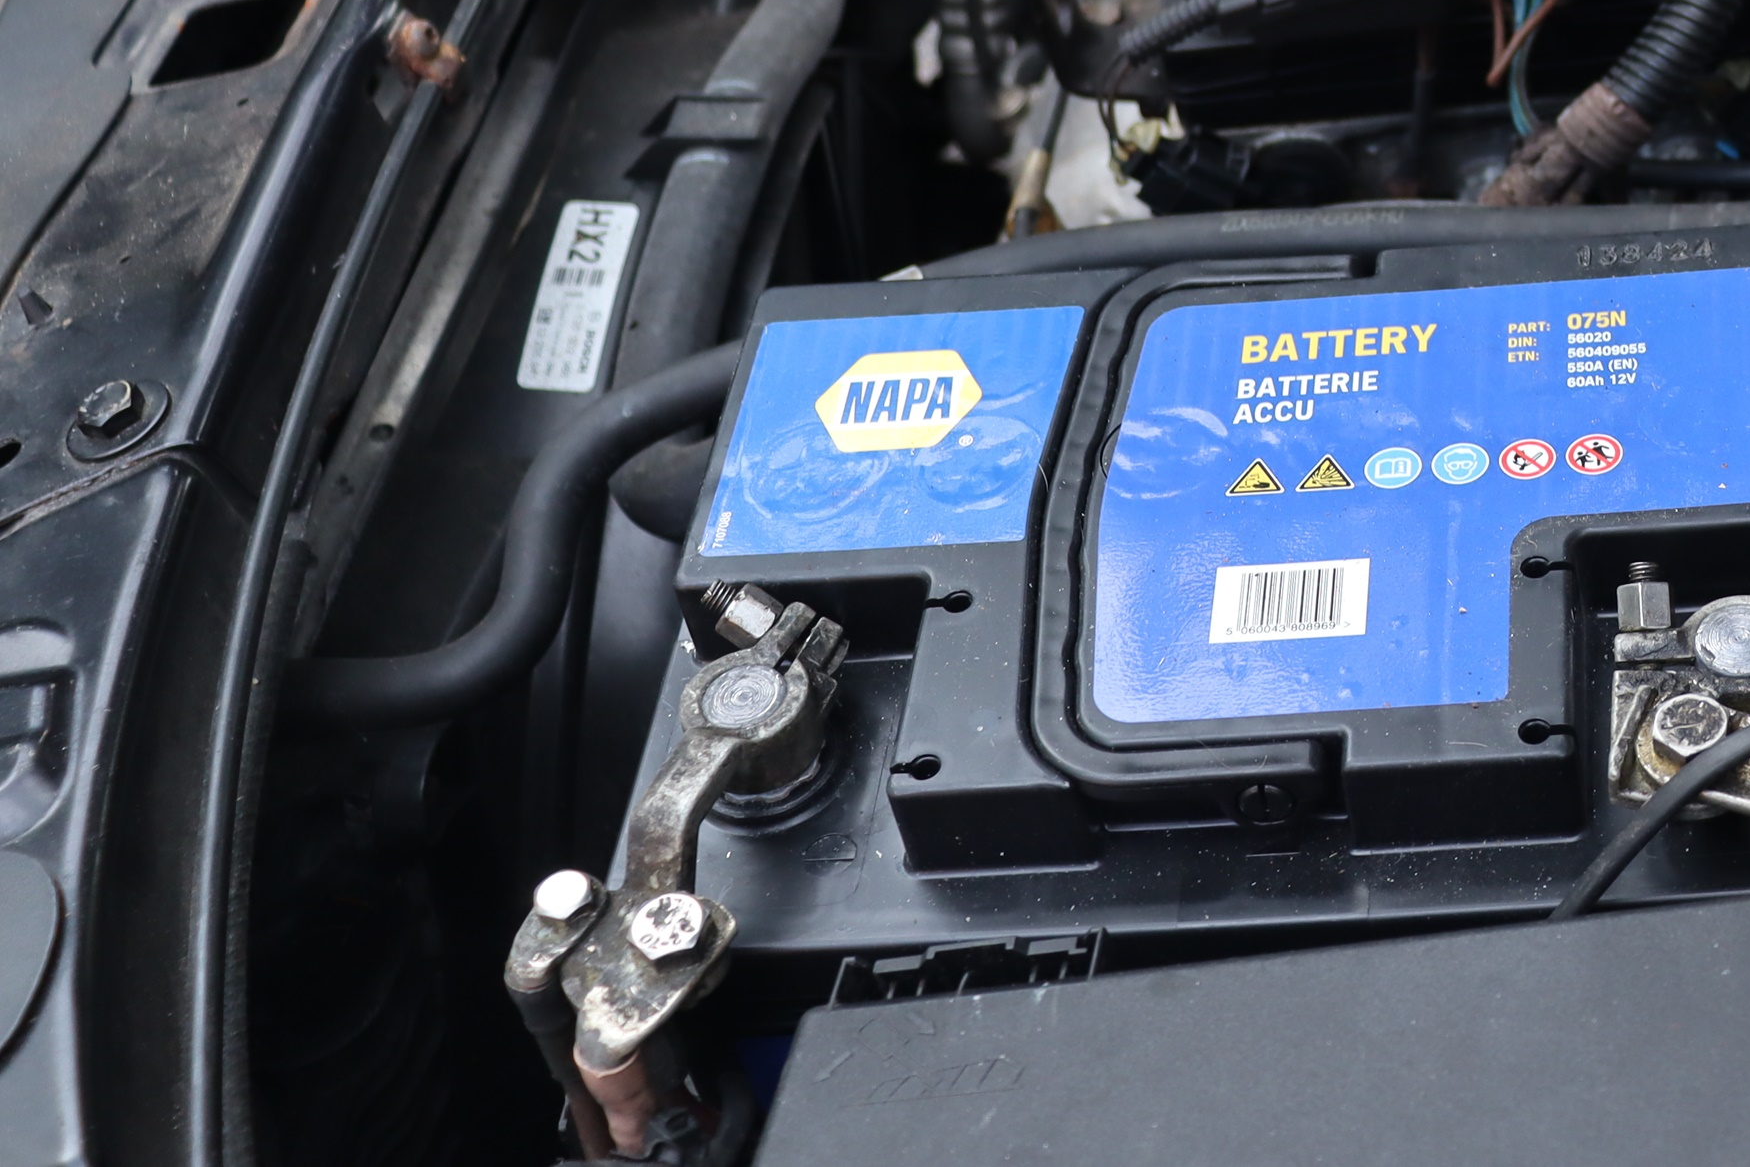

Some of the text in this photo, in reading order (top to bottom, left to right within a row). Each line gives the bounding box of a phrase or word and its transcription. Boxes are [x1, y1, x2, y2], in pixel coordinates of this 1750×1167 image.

[567, 207, 614, 264] HX2
[1577, 237, 1713, 267] 138424
[1508, 321, 1551, 334] PART:
[1240, 324, 1437, 364] BATTERY
[1508, 337, 1537, 348] DIN:
[1567, 331, 1611, 344] 56020
[1508, 351, 1540, 363] ETN:
[1567, 342, 1646, 358] 560409055
[1567, 358, 1638, 373] 550A (EN)
[1236, 370, 1379, 399] BATTERIE
[1566, 373, 1637, 388] 60Ah 12V
[840, 376, 953, 424] NAPA
[1232, 399, 1314, 424] ACCU
[712, 511, 732, 549] 7107088
[1241, 624, 1286, 635] 060043
[1291, 621, 1336, 632] 808969
